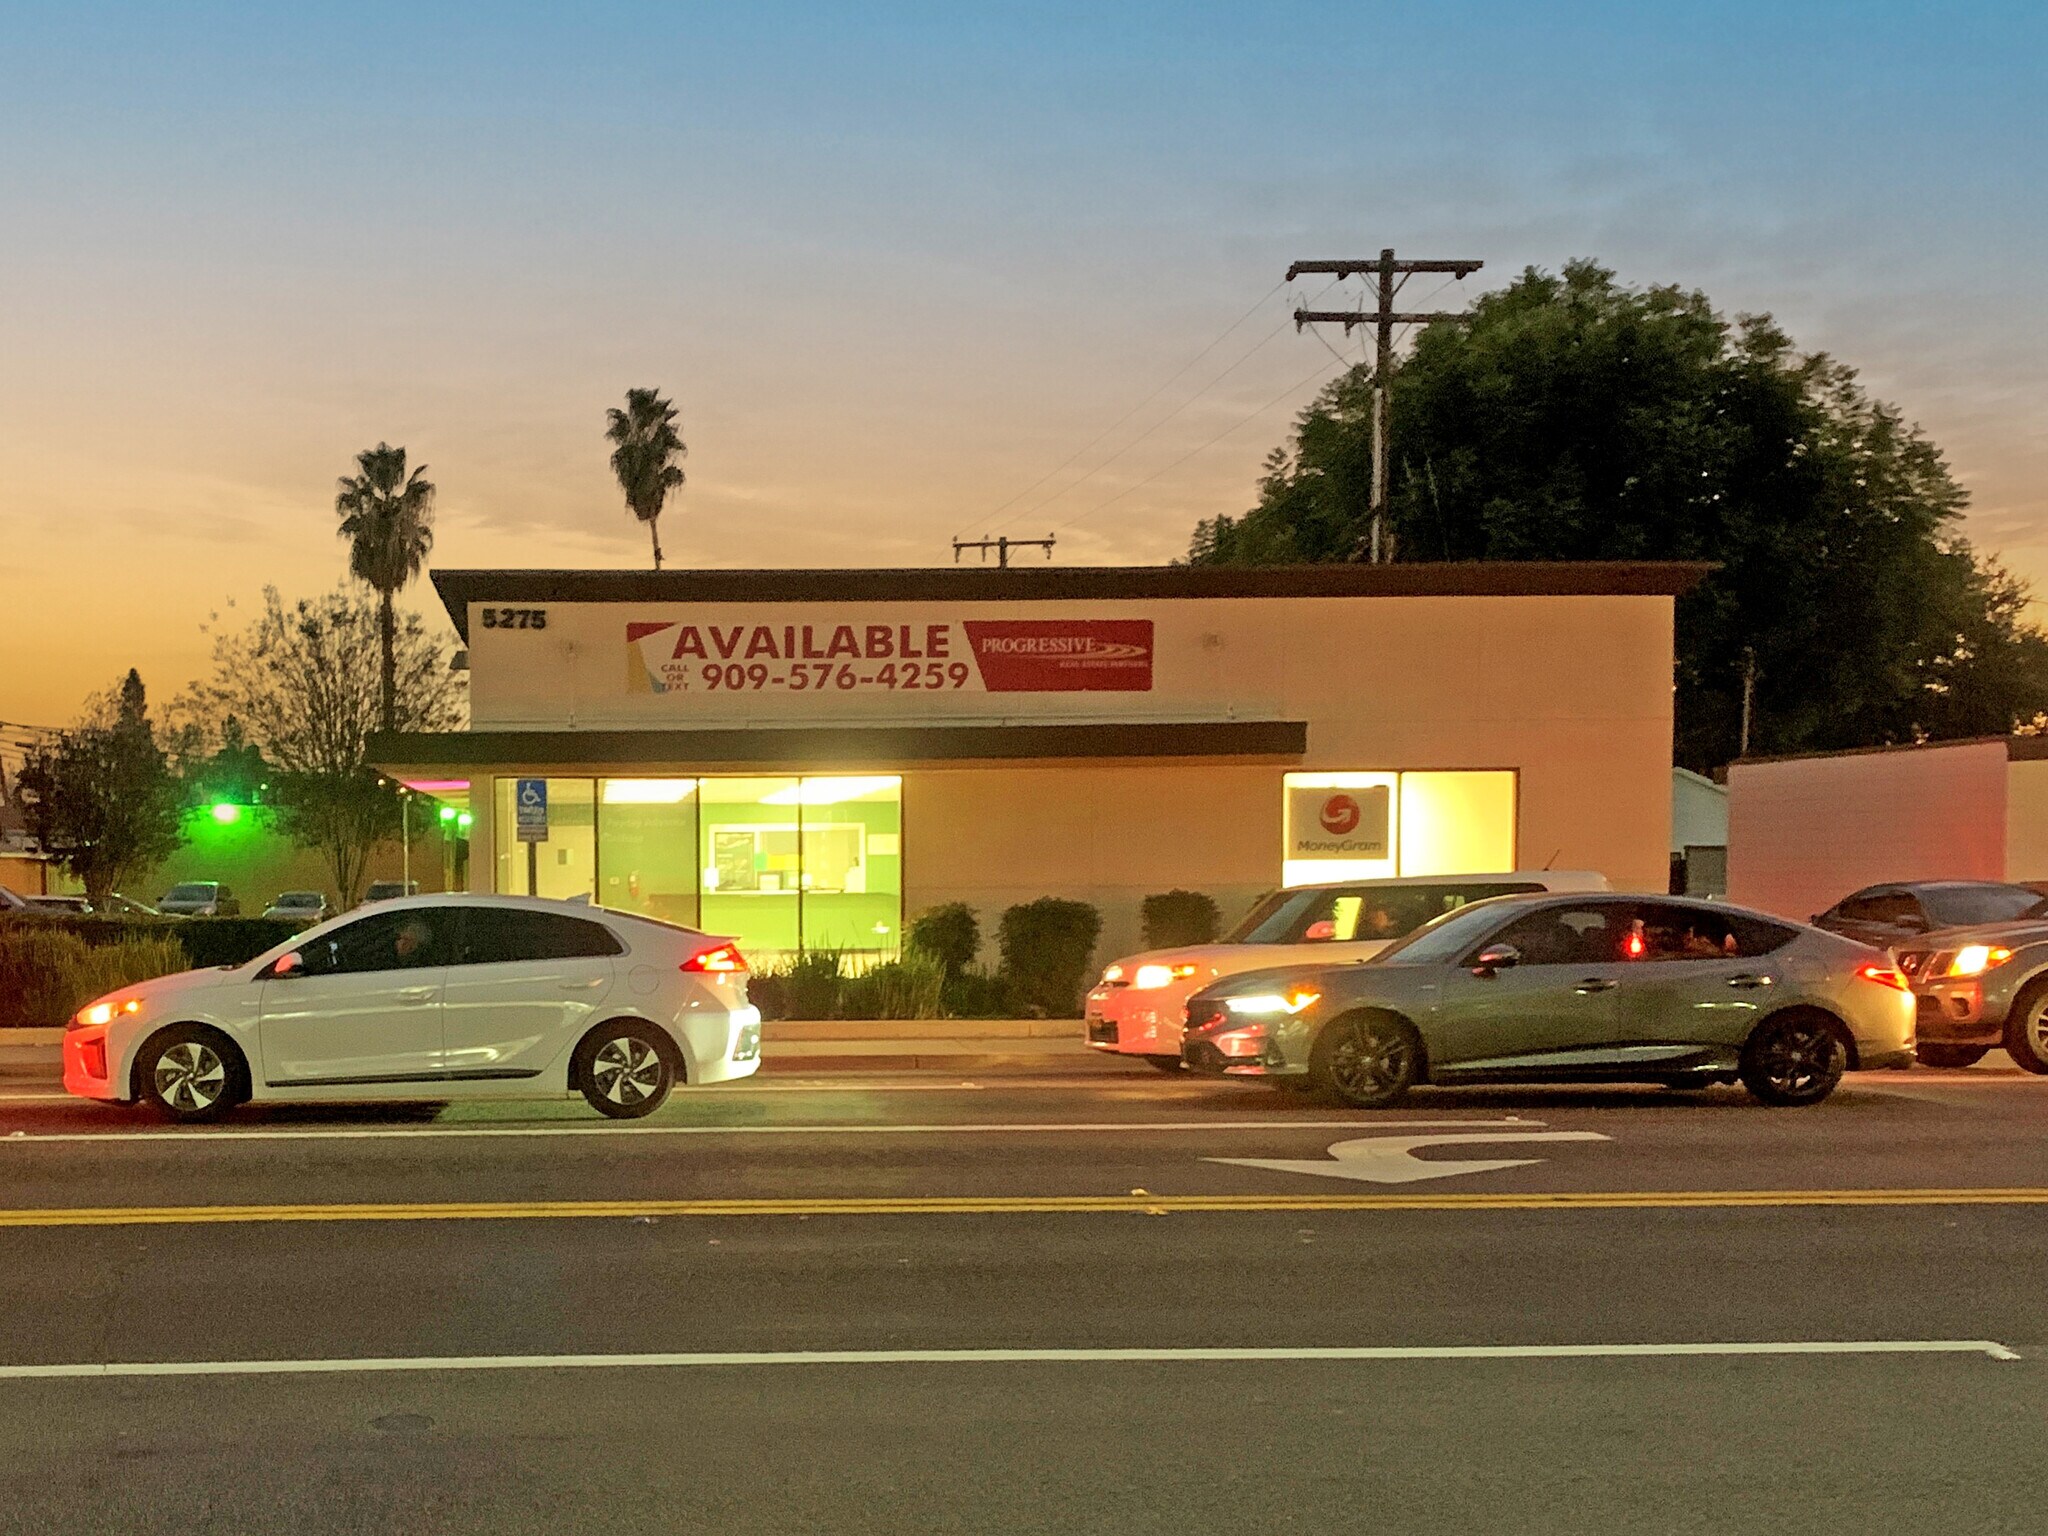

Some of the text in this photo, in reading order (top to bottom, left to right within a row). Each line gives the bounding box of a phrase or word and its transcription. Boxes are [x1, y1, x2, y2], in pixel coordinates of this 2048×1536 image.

[482, 608, 547, 629] 5275
[671, 625, 949, 659] AVAILABLE
[982, 637, 1096, 654] PROGRESSIVE
[660, 664, 689, 672] CALL
[666, 673, 684, 681] OR
[702, 663, 969, 690] 909-576-4259
[662, 682, 689, 690] TEXT
[1298, 839, 1381, 852] MoneyGram
